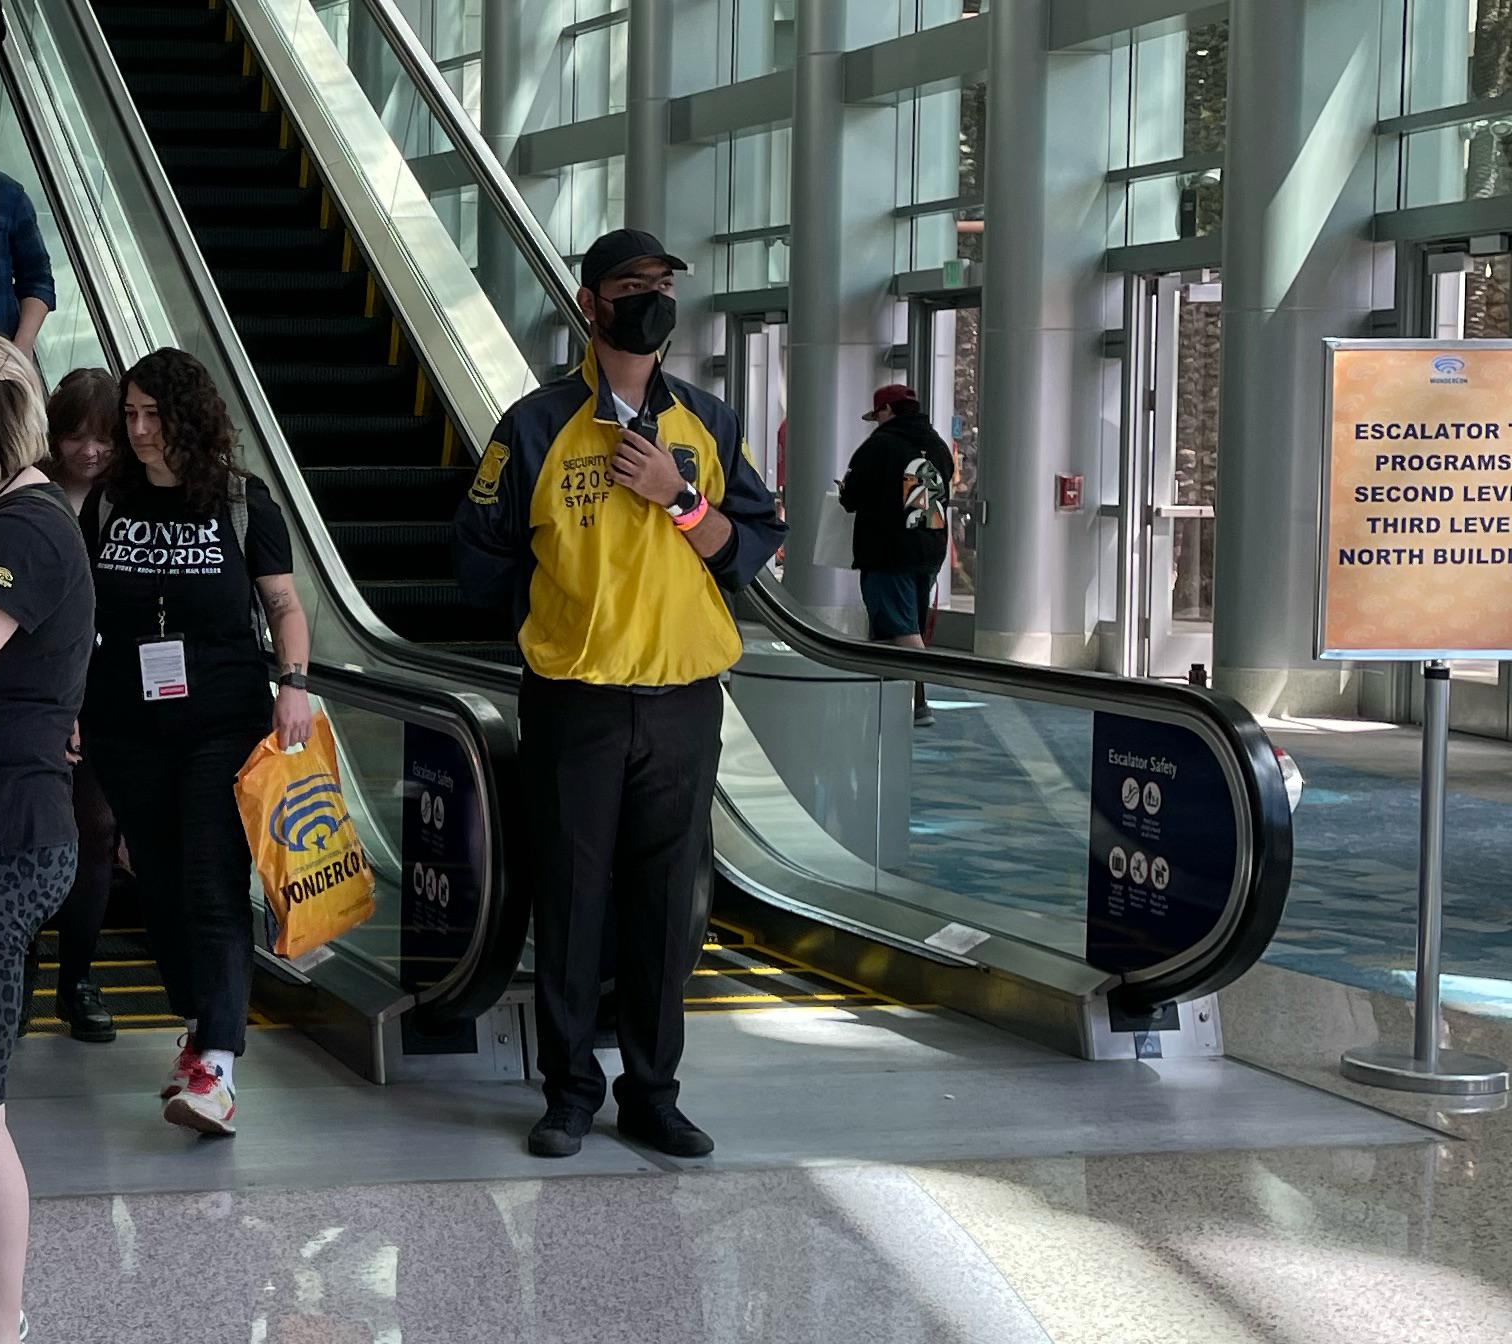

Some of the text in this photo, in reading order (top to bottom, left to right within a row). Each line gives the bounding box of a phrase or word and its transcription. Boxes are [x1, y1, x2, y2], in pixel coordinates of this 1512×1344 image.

[1354, 423, 1500, 440] ESCALATOR
[562, 455, 608, 471] SECURITY
[1375, 454, 1511, 471] PROGRAMS
[564, 492, 610, 508] STAFF
[1354, 485, 1512, 503] SECOND LEV
[579, 514, 595, 528] 41
[1366, 516, 1510, 534] THIRD LEVE
[110, 516, 221, 546] GONER
[99, 542, 225, 566] RECORDS
[1339, 548, 1424, 565] NORTH
[1108, 748, 1178, 780] Escalator Safety
